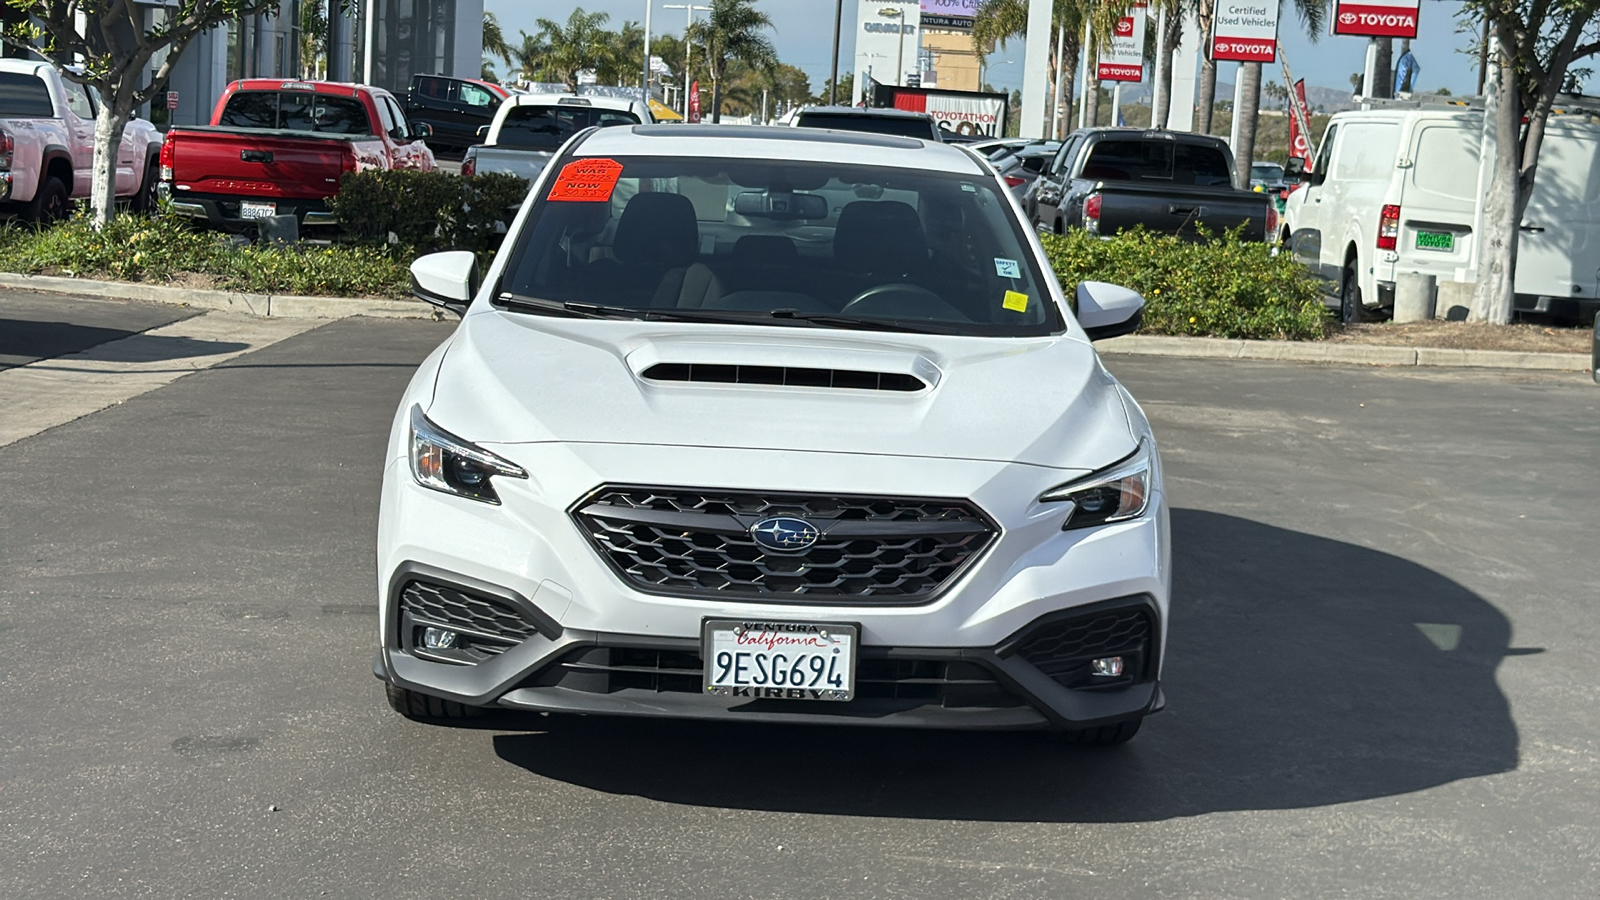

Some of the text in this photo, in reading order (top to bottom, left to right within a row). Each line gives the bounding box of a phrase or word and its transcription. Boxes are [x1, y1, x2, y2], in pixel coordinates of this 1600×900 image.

[1228, 6, 1266, 16] Certified
[920, 17, 973, 27] NTURA AUTO
[1217, 16, 1275, 27] Used Vehicles
[1358, 13, 1415, 28] TOYOTA
[1230, 43, 1274, 55] TOYOTA
[1110, 68, 1141, 77] TOYOTA
[930, 110, 997, 123] TOYOTATHON
[1419, 233, 1451, 242] VENTURA
[743, 622, 819, 633] VENTURA
[737, 630, 827, 650] California
[715, 651, 843, 688] 9ESG694
[732, 686, 826, 699] KIRBY
